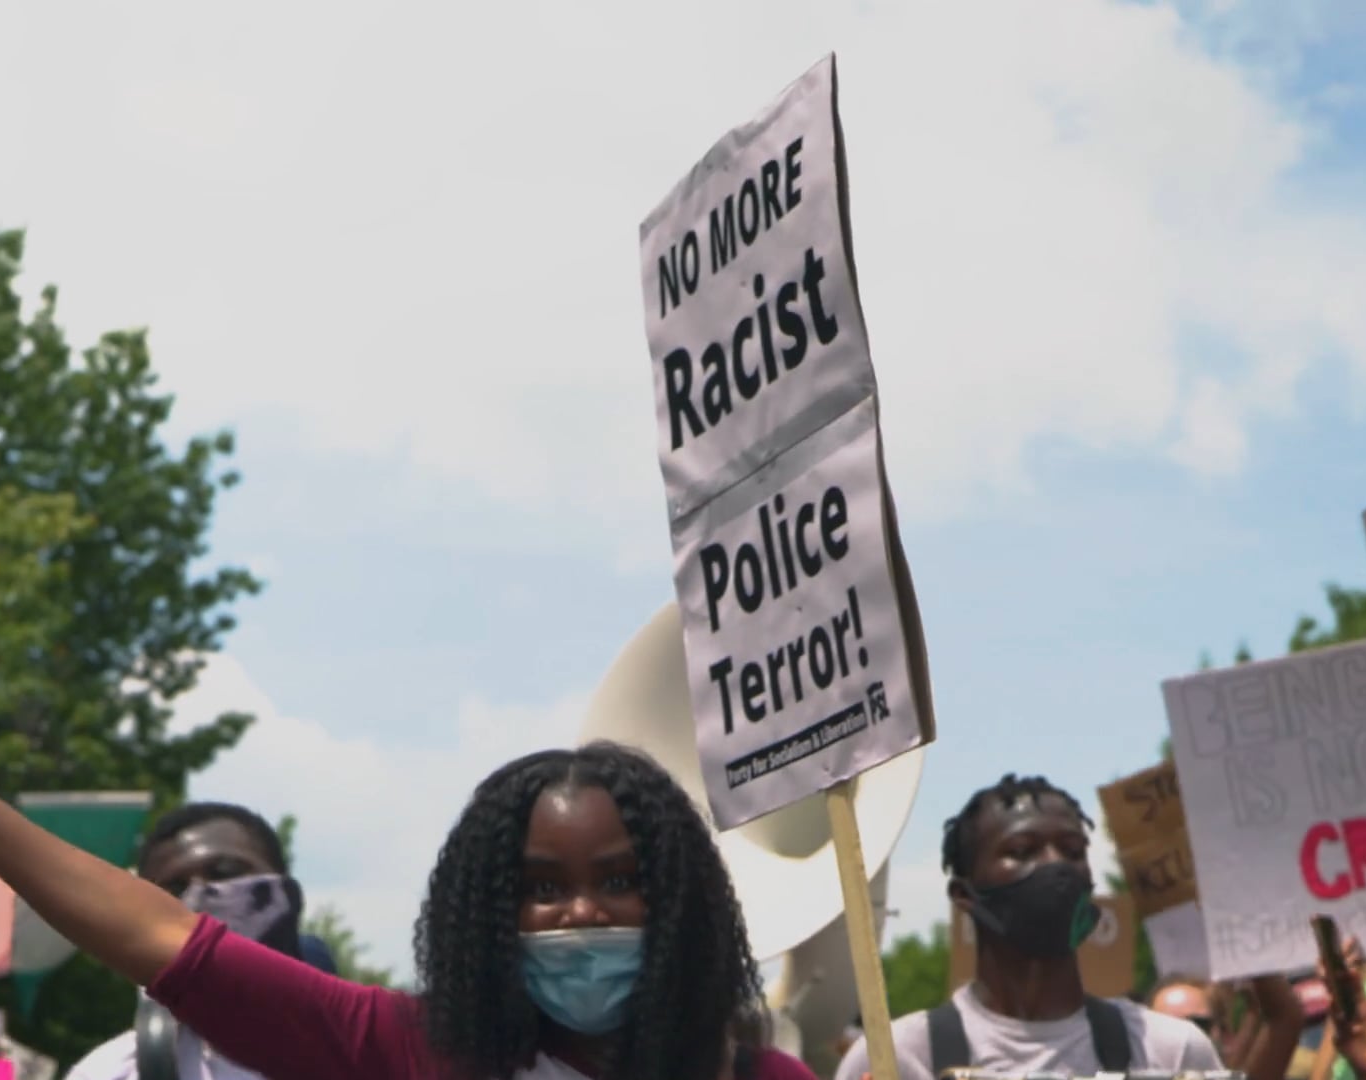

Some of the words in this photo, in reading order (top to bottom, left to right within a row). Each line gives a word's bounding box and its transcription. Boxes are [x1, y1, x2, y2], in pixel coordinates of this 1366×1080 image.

[658, 229, 700, 319] NO
[709, 136, 803, 275] MORE
[663, 246, 839, 452] Racist
[699, 485, 849, 633] Police
[709, 585, 869, 735] Terror!
[819, 712, 867, 747] Liberation
